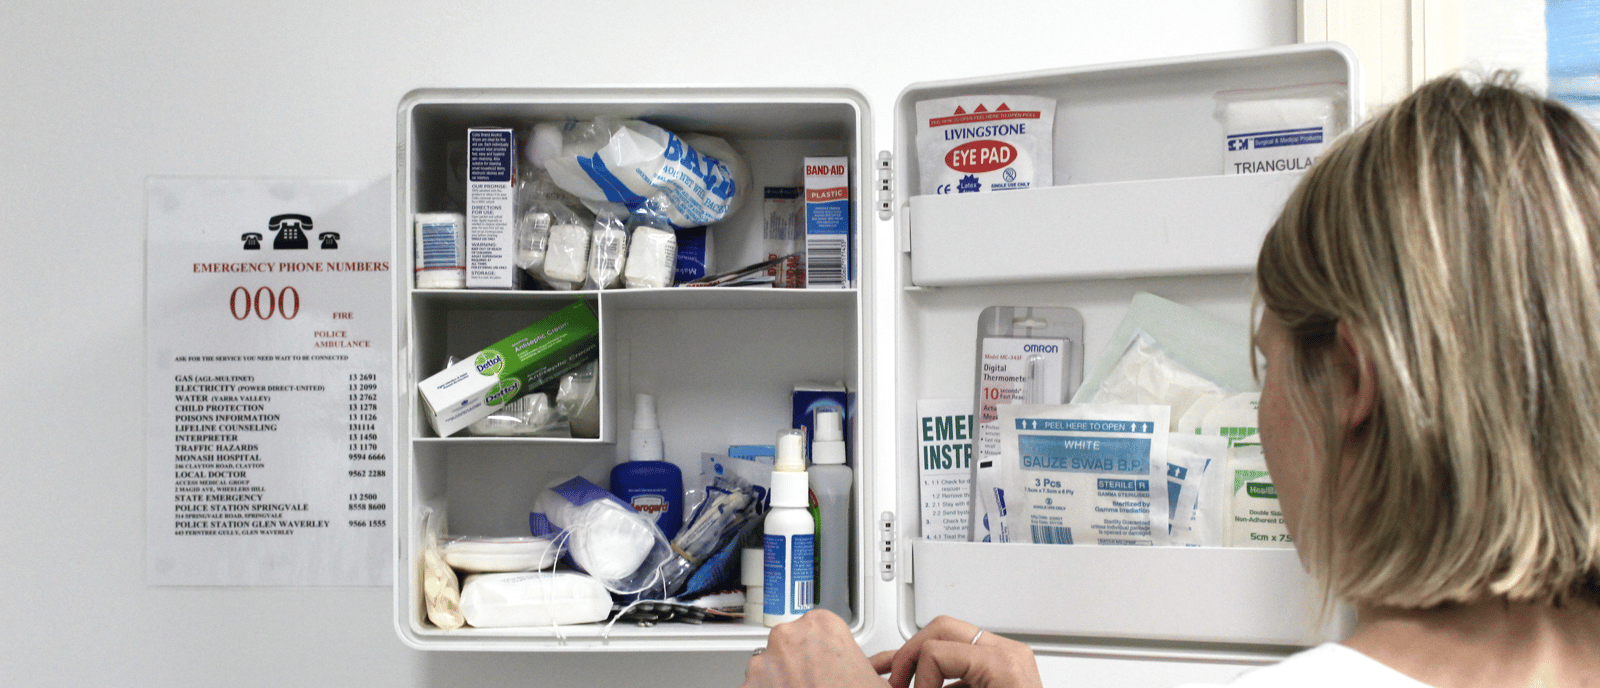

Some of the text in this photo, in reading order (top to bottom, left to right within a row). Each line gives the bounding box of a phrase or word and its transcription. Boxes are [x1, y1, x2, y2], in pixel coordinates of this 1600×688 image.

[945, 124, 1026, 140] LIVINGSTONE
[953, 146, 1010, 167] EYE PAD
[807, 165, 844, 175] BAND-AID
[1234, 157, 1315, 174] TRIANGULA
[194, 262, 389, 273] EMERGENCY PHONE NUMBERS
[230, 286, 300, 320] 000
[515, 334, 546, 353] Antiseptic
[547, 322, 568, 335] Cream
[1024, 344, 1058, 353] OMRON
[476, 355, 501, 372] Dettol
[984, 364, 1006, 373] Digital
[486, 383, 518, 404] Dettol
[984, 388, 998, 400] 10
[1064, 440, 1100, 450] WHITE
[1023, 456, 1143, 471] GAUZE SWAB B.P.
[1035, 478, 1061, 488] 3 Pcs
